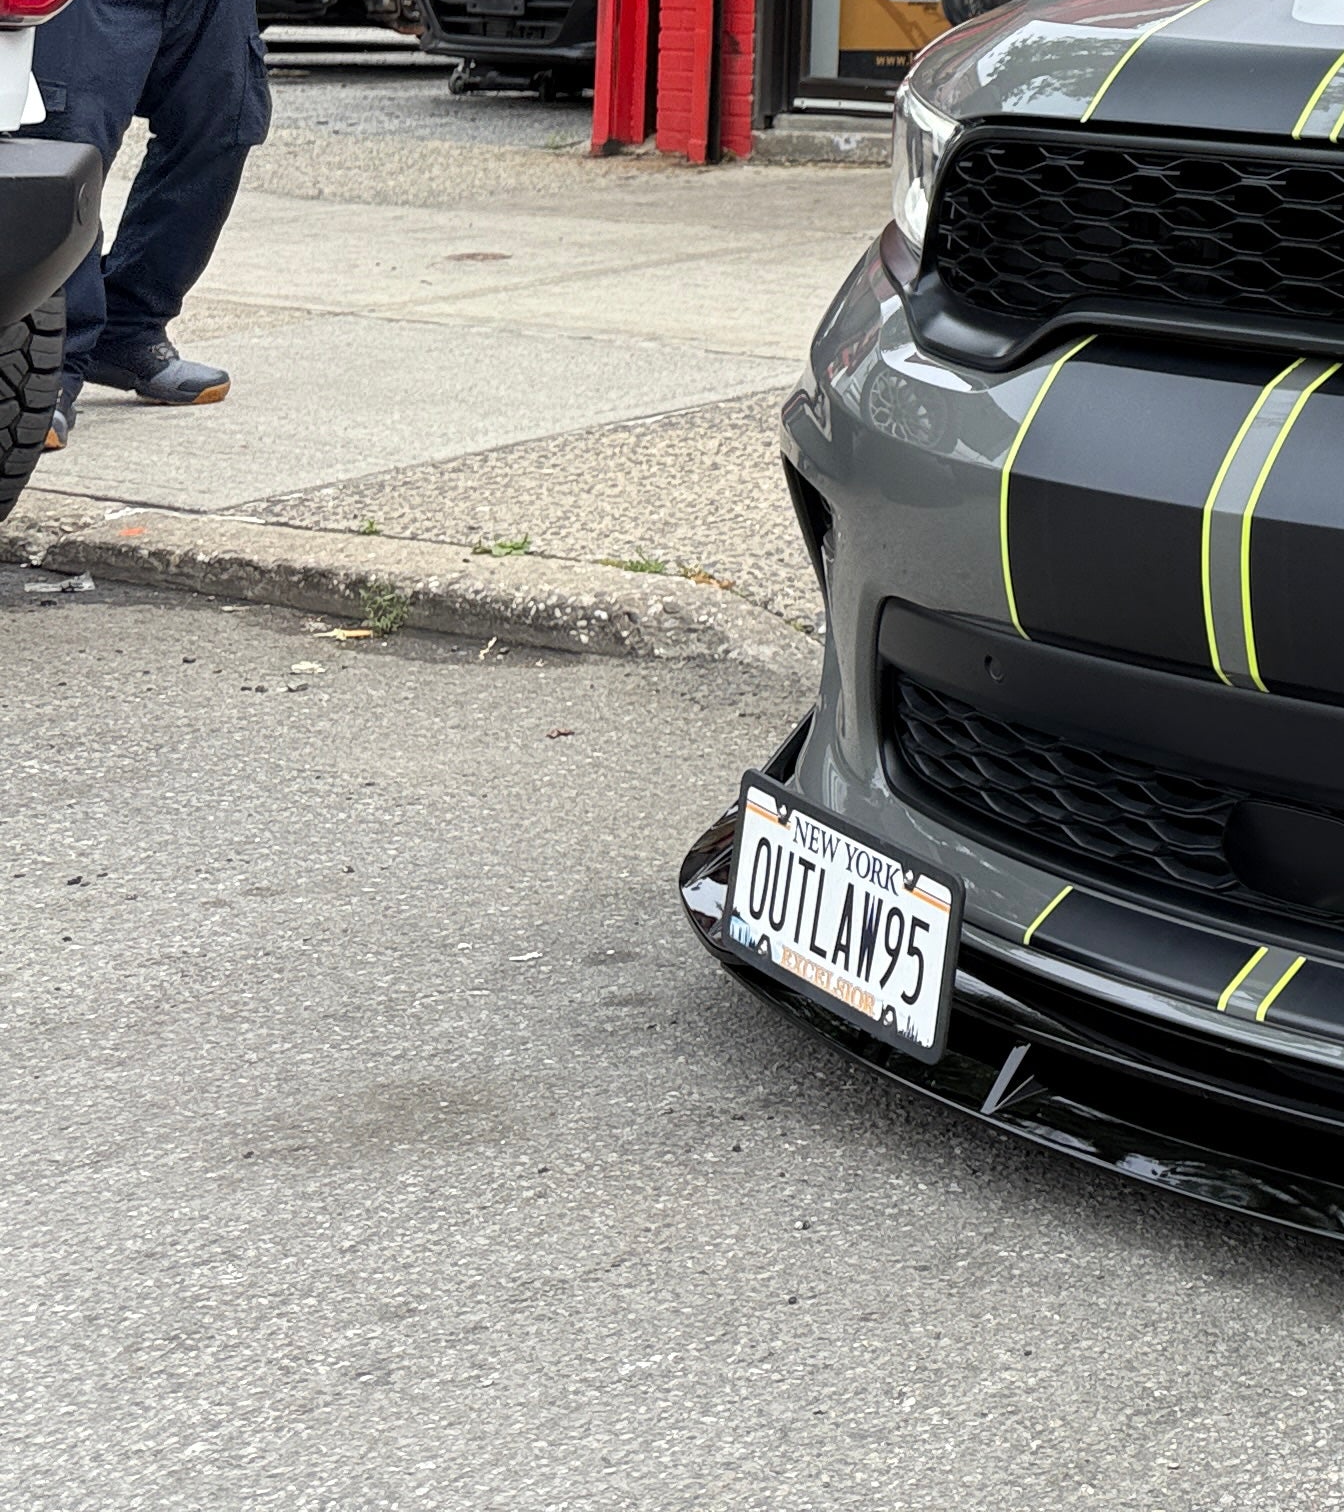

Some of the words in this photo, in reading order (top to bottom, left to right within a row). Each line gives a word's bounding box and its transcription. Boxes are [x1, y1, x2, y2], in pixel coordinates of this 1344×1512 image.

[792, 816, 842, 863] NEW
[844, 841, 901, 897] YORK
[748, 836, 931, 1006] OUTLAW95
[779, 944, 877, 1018] EXCELSIOR
